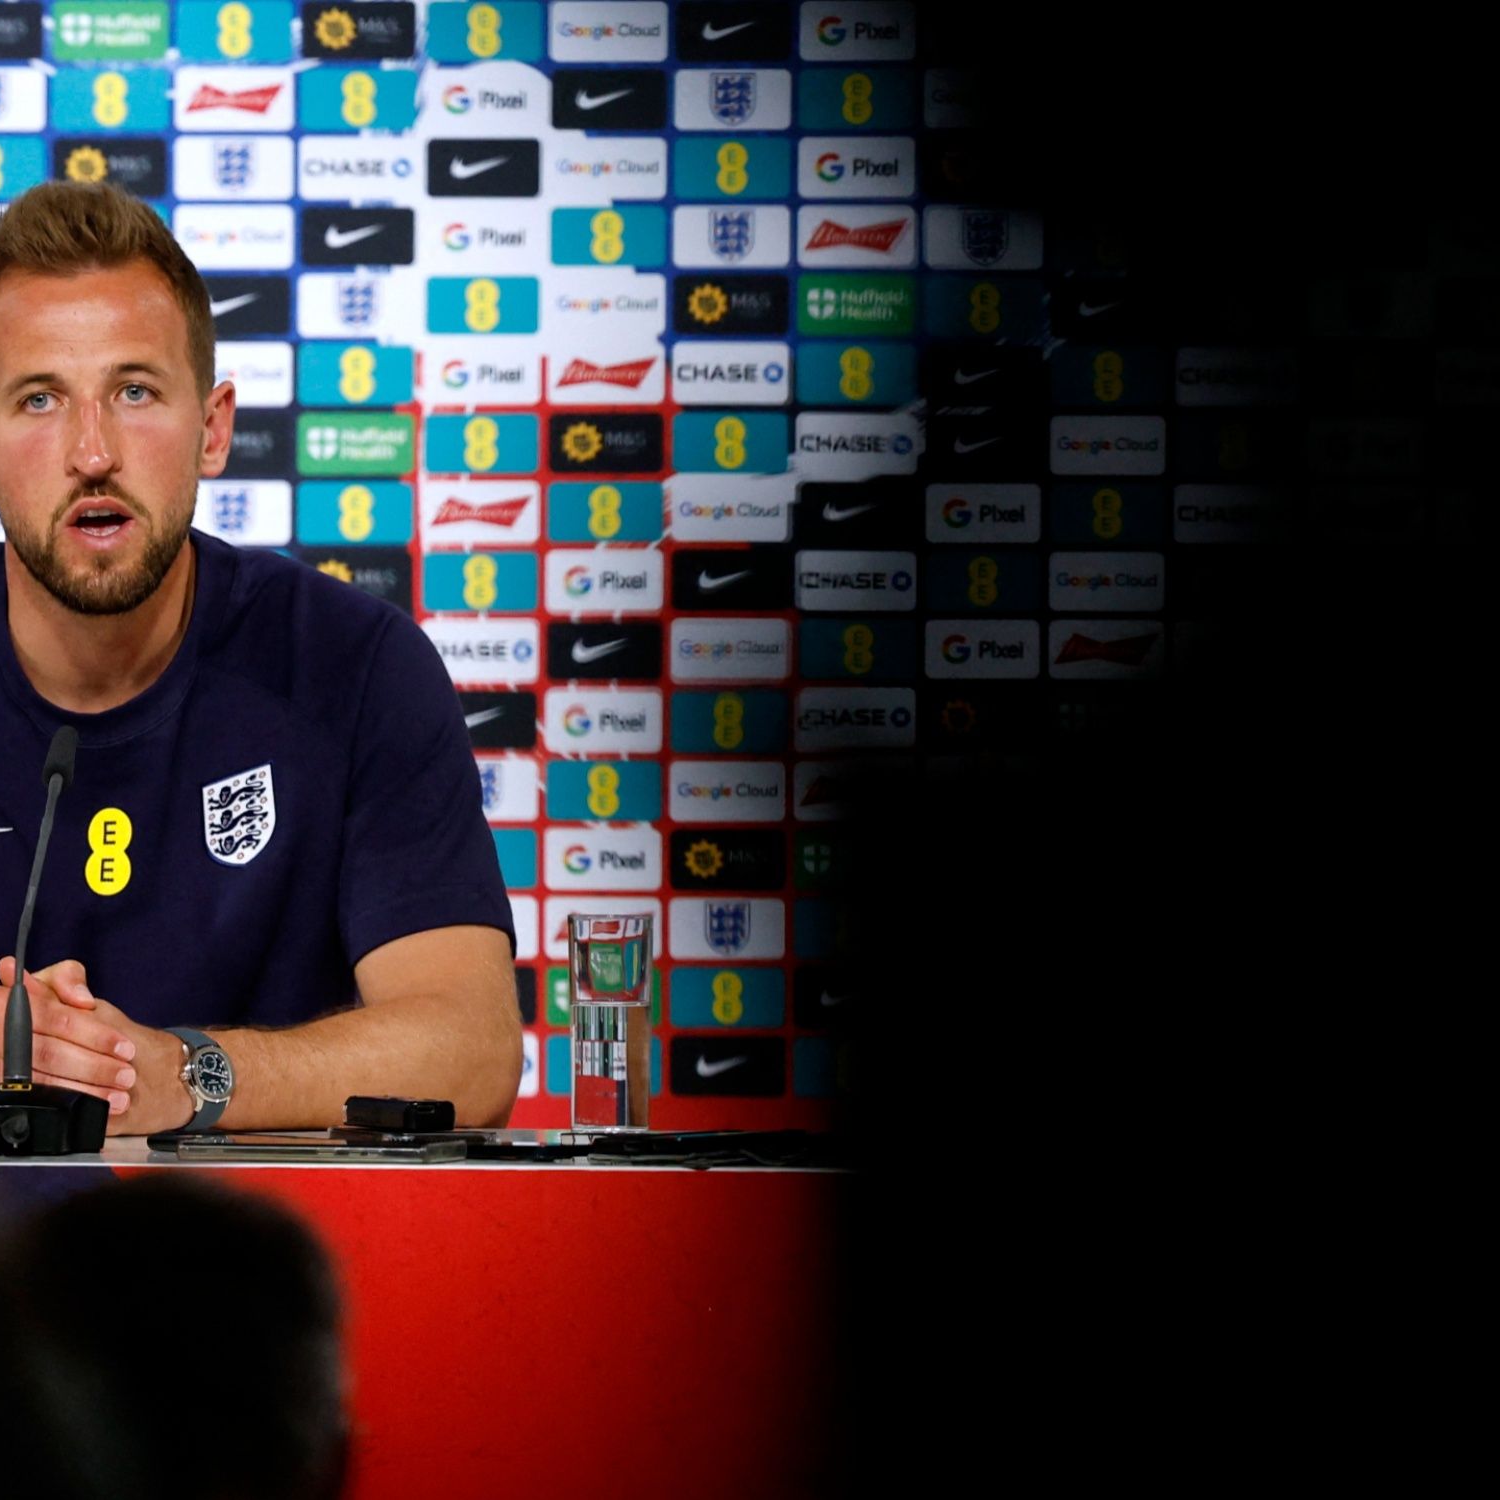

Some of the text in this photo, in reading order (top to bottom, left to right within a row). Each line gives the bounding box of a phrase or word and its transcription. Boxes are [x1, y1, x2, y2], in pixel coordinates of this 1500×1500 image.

[560, 23, 660, 41] Google Cloud
[854, 23, 899, 40] Pixel
[480, 92, 525, 109] Pixel
[303, 161, 383, 178] CHASE
[559, 161, 659, 179] Google Cloud
[852, 159, 897, 176] Pixel
[479, 229, 524, 246] Pixel
[557, 298, 657, 316] Google Cloud
[479, 366, 524, 383] Pixel
[677, 364, 757, 381] CHASE
[802, 435, 886, 452] CHASE
[1058, 437, 1159, 455] Google Cloud
[680, 503, 780, 521] Google Cloud
[980, 504, 1025, 521] Pixel
[602, 571, 647, 588] Pixel
[801, 572, 886, 589] CHASE
[1056, 573, 1157, 591] Google Cloud
[680, 639, 780, 657] Google Cloud
[979, 640, 1024, 657] Pixel
[600, 711, 645, 728] Pixel
[803, 709, 885, 726] CHASE
[678, 782, 778, 800] Google Cloud
[602, 849, 647, 866] Pixel
